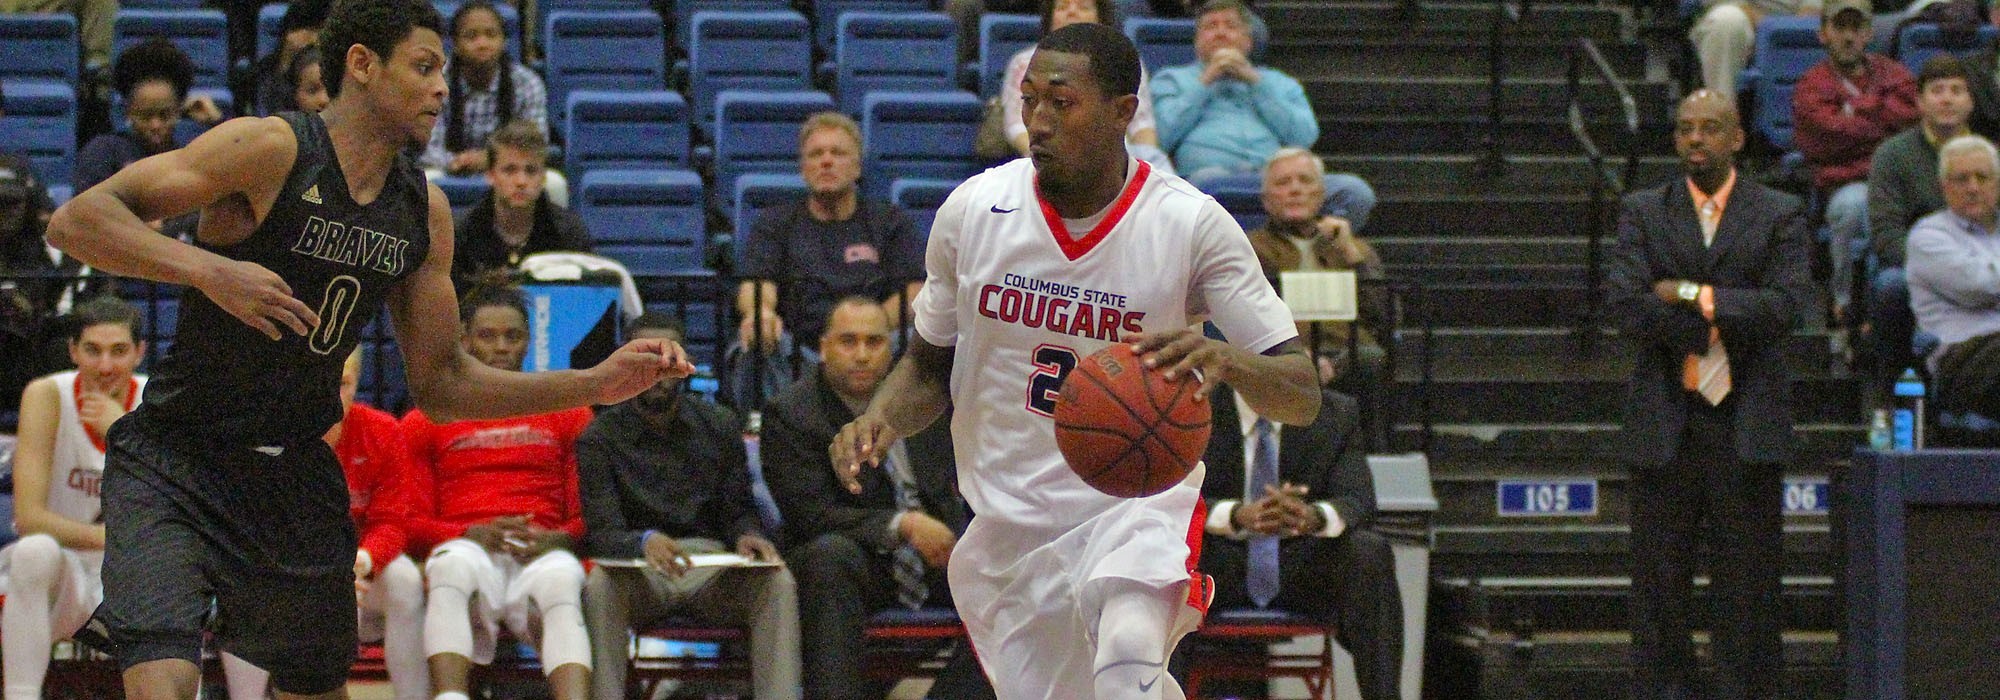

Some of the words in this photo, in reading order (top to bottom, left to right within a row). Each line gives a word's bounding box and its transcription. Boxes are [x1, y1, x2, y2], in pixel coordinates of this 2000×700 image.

[291, 216, 409, 276] BRAVES
[309, 275, 361, 355] 0
[978, 284, 1147, 342] COUGARS
[1004, 273, 1080, 298] COLUMBUS
[1084, 289, 1127, 308] STATE
[1025, 343, 1081, 418] 2
[1526, 486, 1569, 511] 105
[1785, 485, 1817, 510] 06
